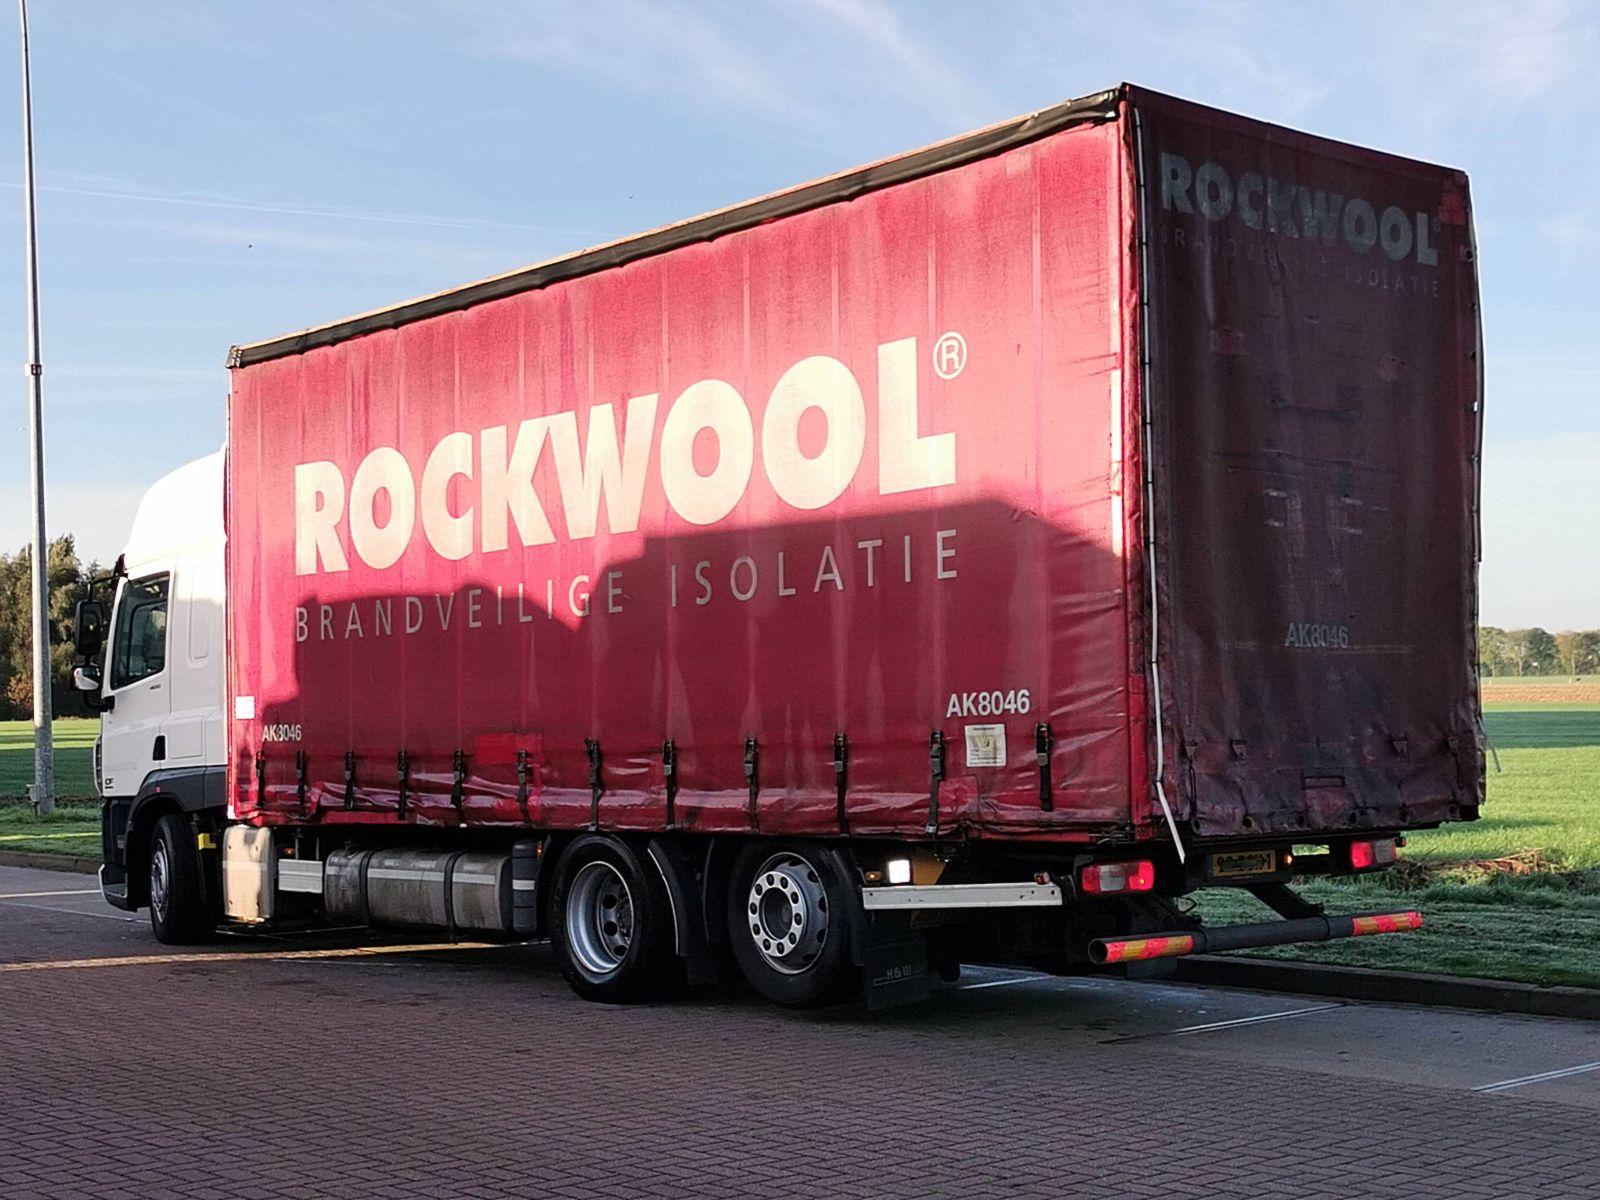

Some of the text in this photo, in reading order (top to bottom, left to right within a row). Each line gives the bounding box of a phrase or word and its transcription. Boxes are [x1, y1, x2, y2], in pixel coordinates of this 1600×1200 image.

[295, 528, 959, 643] BRANDVEILIGE ISOLATIE
[1284, 623, 1350, 649] AK8046
[946, 689, 1031, 718] AK8046
